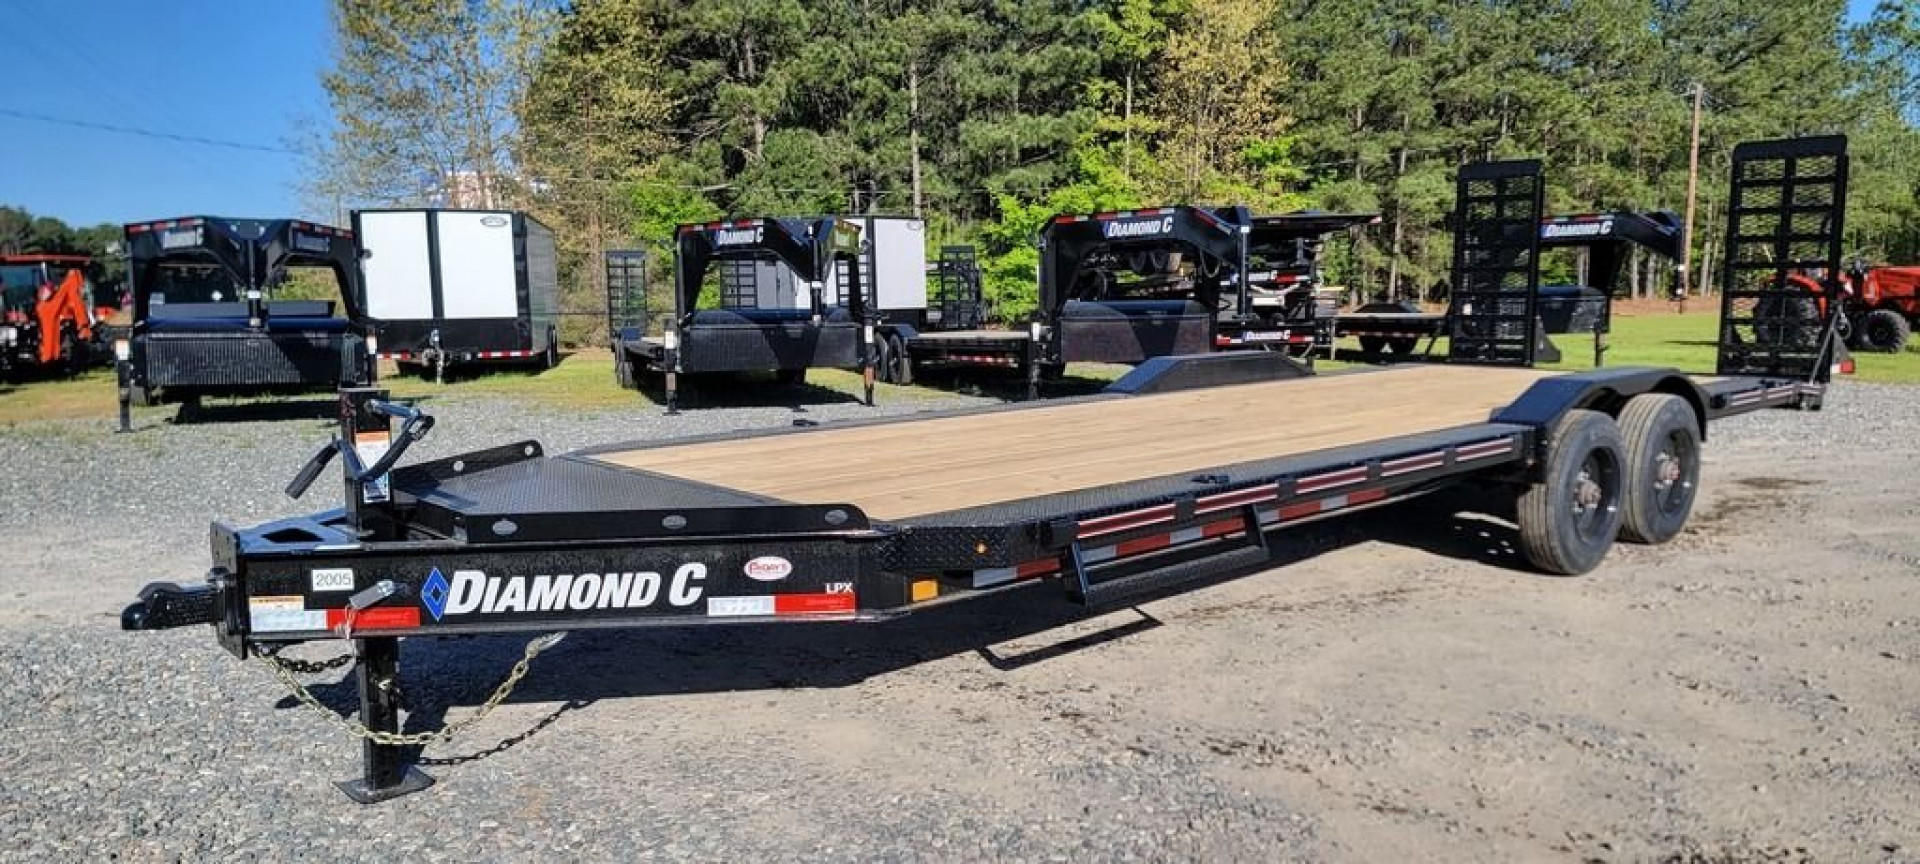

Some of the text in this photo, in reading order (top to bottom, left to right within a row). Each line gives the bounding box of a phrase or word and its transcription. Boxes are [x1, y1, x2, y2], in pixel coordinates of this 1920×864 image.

[1108, 216, 1173, 236] DIAMOND C
[1600, 220, 1613, 235] C
[756, 226, 764, 242] C
[316, 572, 351, 586] 2005
[444, 562, 708, 615] DIAMOND C
[826, 582, 853, 594] LPX
